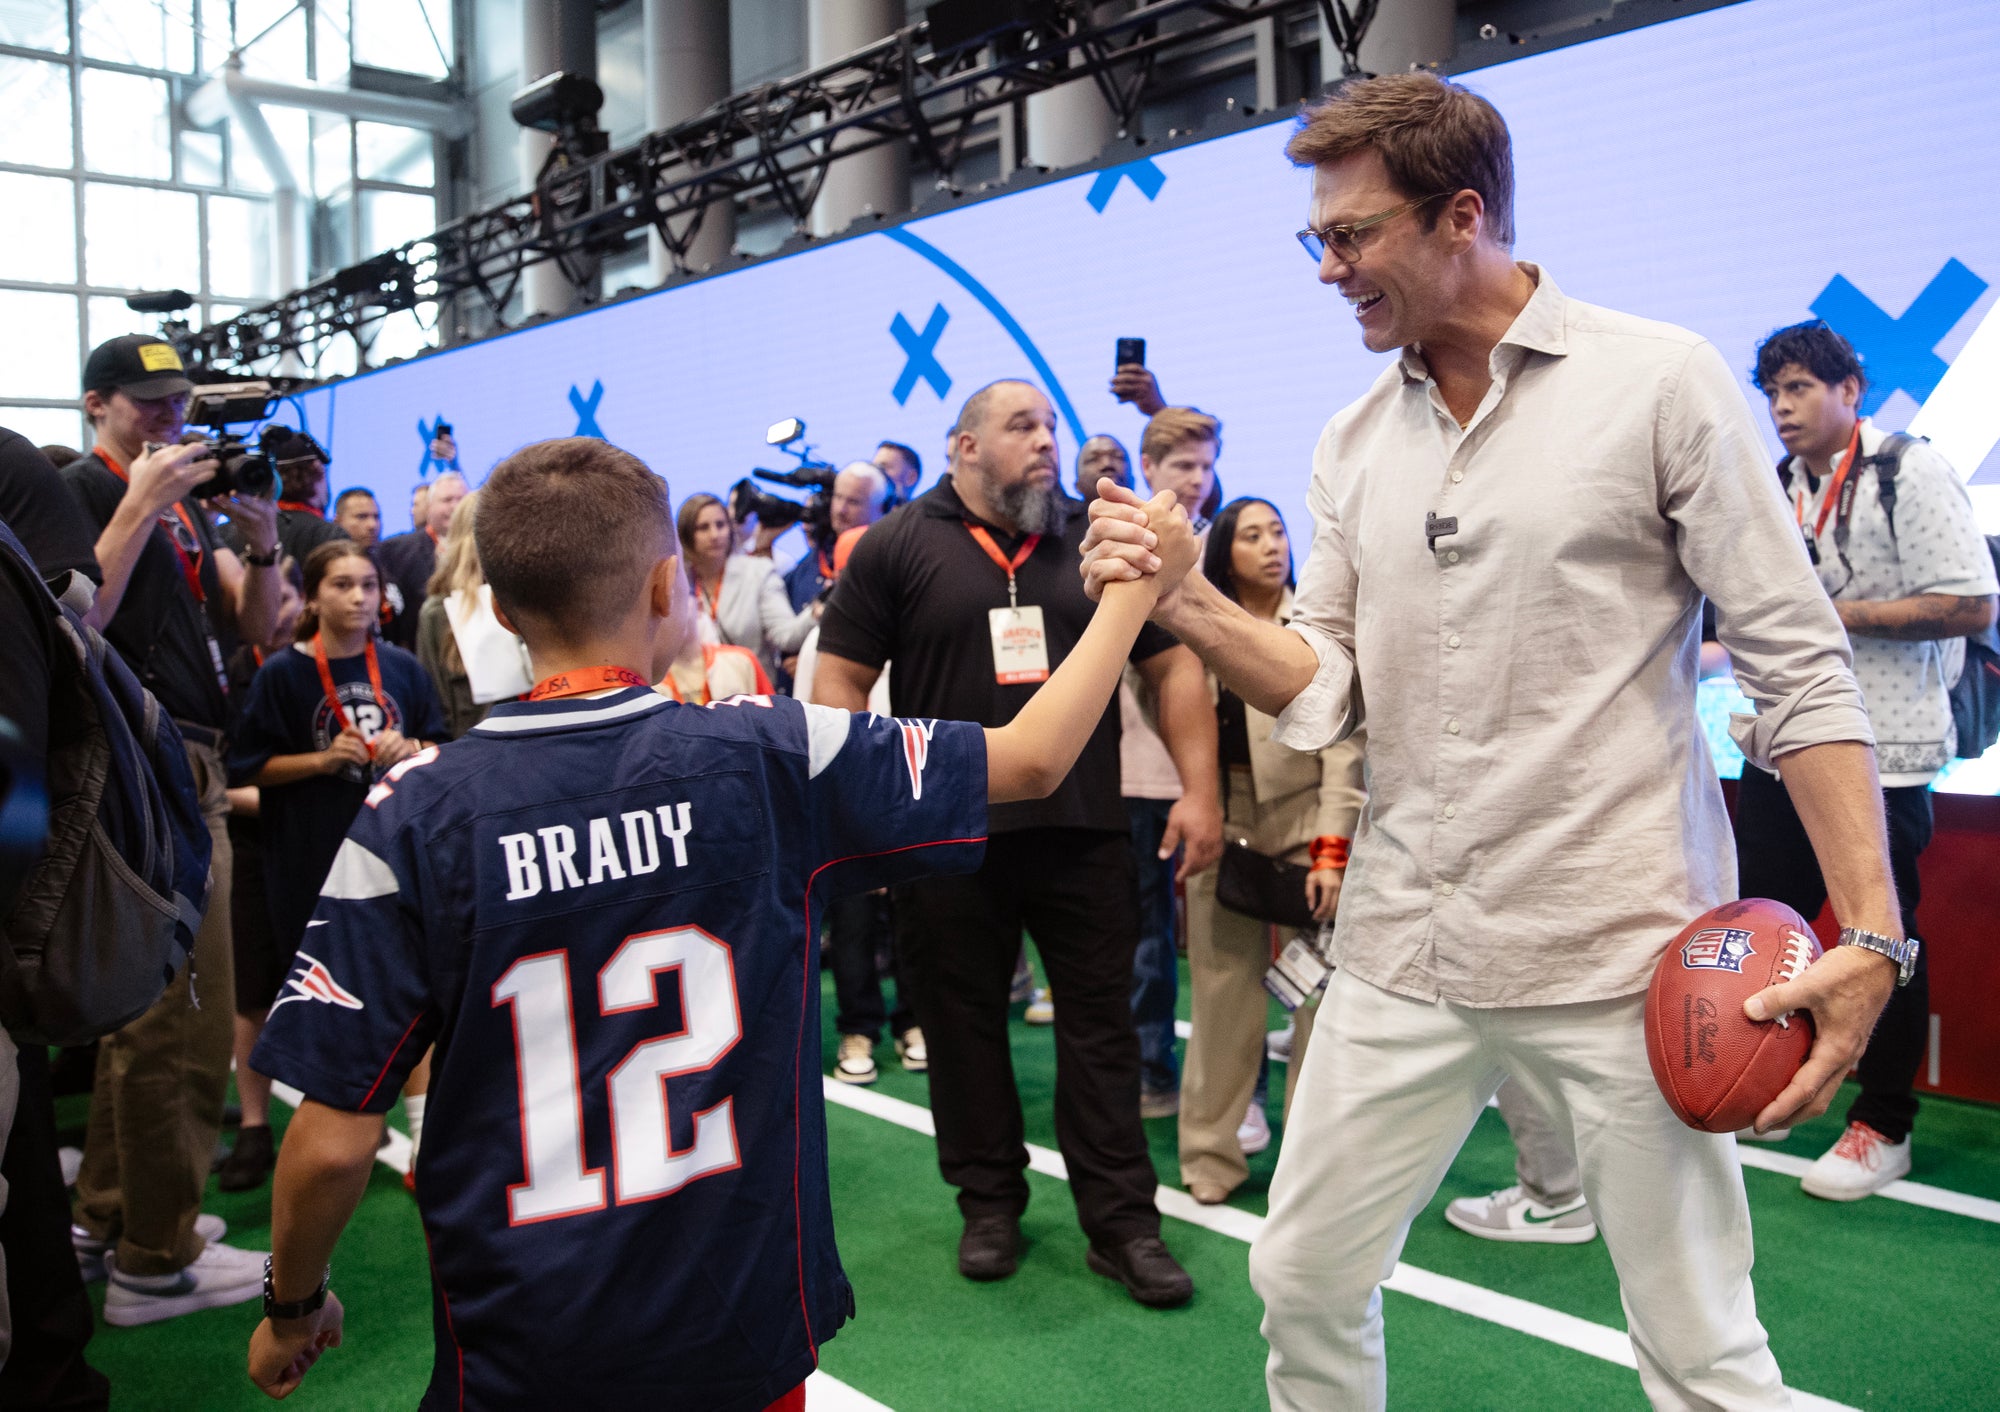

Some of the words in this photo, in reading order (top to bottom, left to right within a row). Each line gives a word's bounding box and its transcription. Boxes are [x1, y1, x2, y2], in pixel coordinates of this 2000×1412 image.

[1840, 480, 1854, 517] Canon
[498, 801, 693, 901] BRADY
[1689, 931, 1725, 965] NFL
[1684, 993, 1693, 1070] COMMISSIONER
[491, 923, 743, 1228] 12
